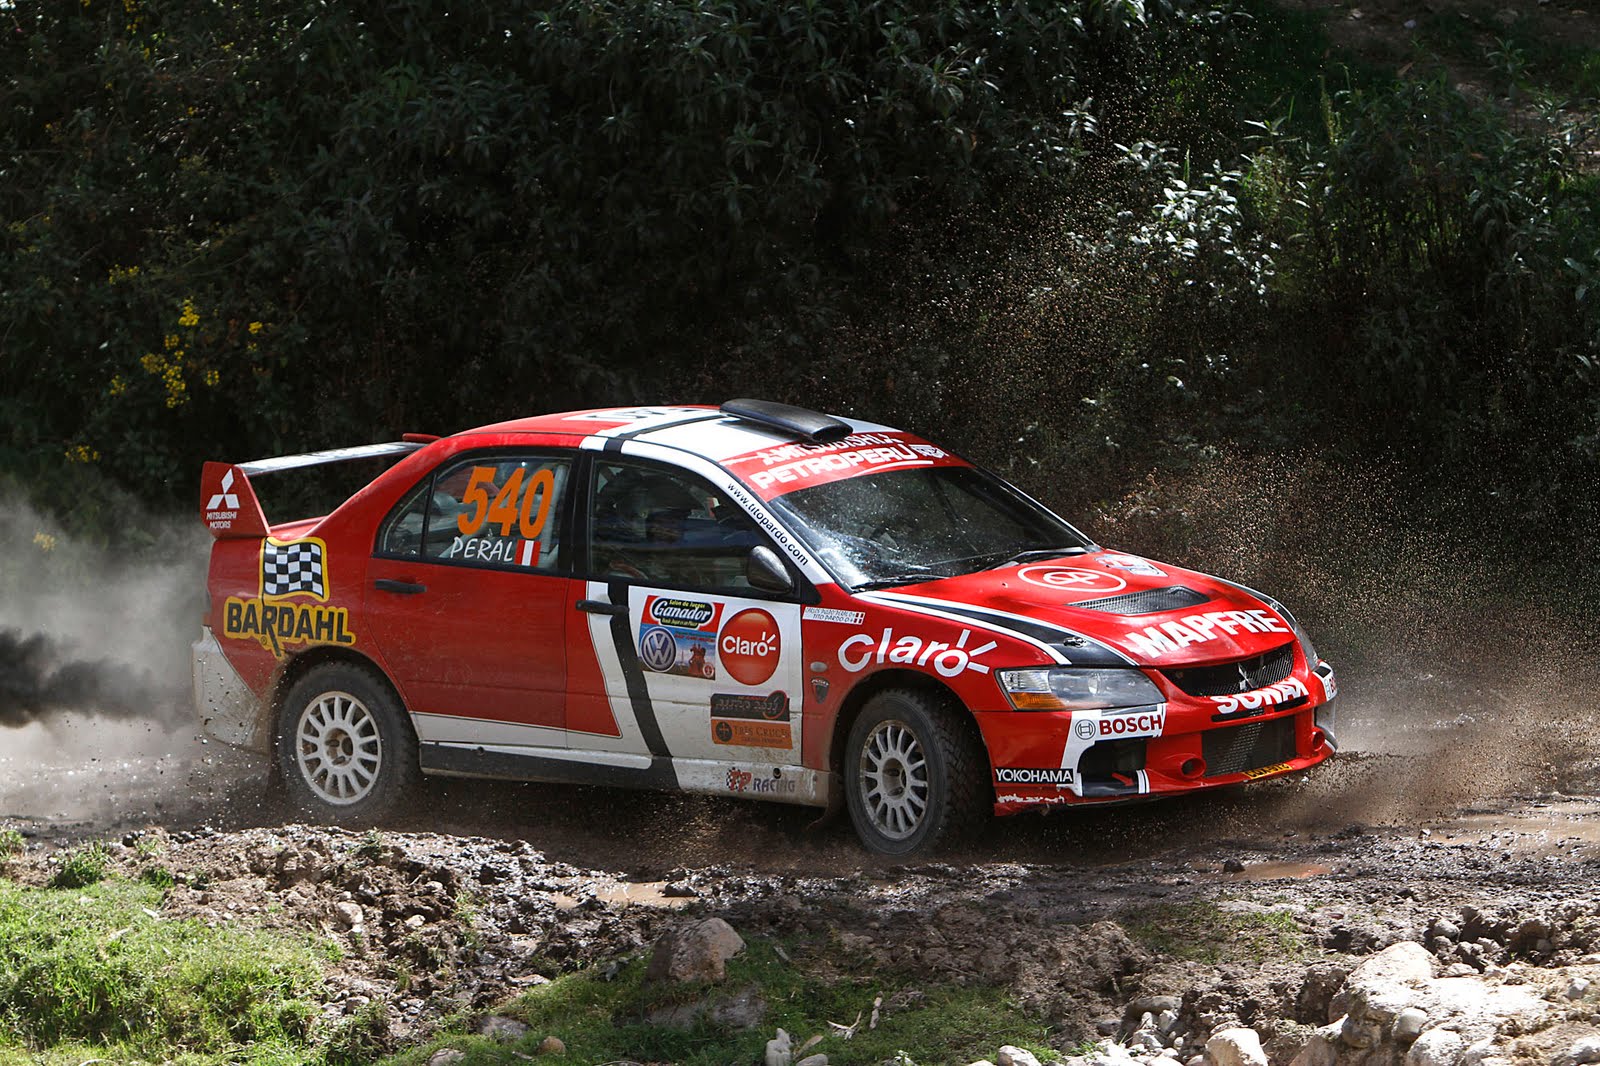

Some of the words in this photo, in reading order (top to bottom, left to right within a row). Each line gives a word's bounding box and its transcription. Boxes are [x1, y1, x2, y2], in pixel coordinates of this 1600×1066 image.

[457, 465, 554, 539] 540
[206, 511, 237, 520] MITSUBISHI
[210, 520, 231, 529] MOTORS
[728, 483, 809, 566] www.titopardo.com
[450, 536, 513, 562] PERAL
[654, 600, 711, 620] Ganador
[227, 602, 352, 657] BARDAHL
[1125, 610, 1289, 658] MAPFRE
[722, 635, 769, 656] Claro
[838, 628, 969, 677] Claro
[1210, 677, 1309, 714] SONAX
[1099, 715, 1163, 736] BOSCH
[753, 777, 796, 793] RACING
[995, 768, 1073, 782] YOKOHAMA
